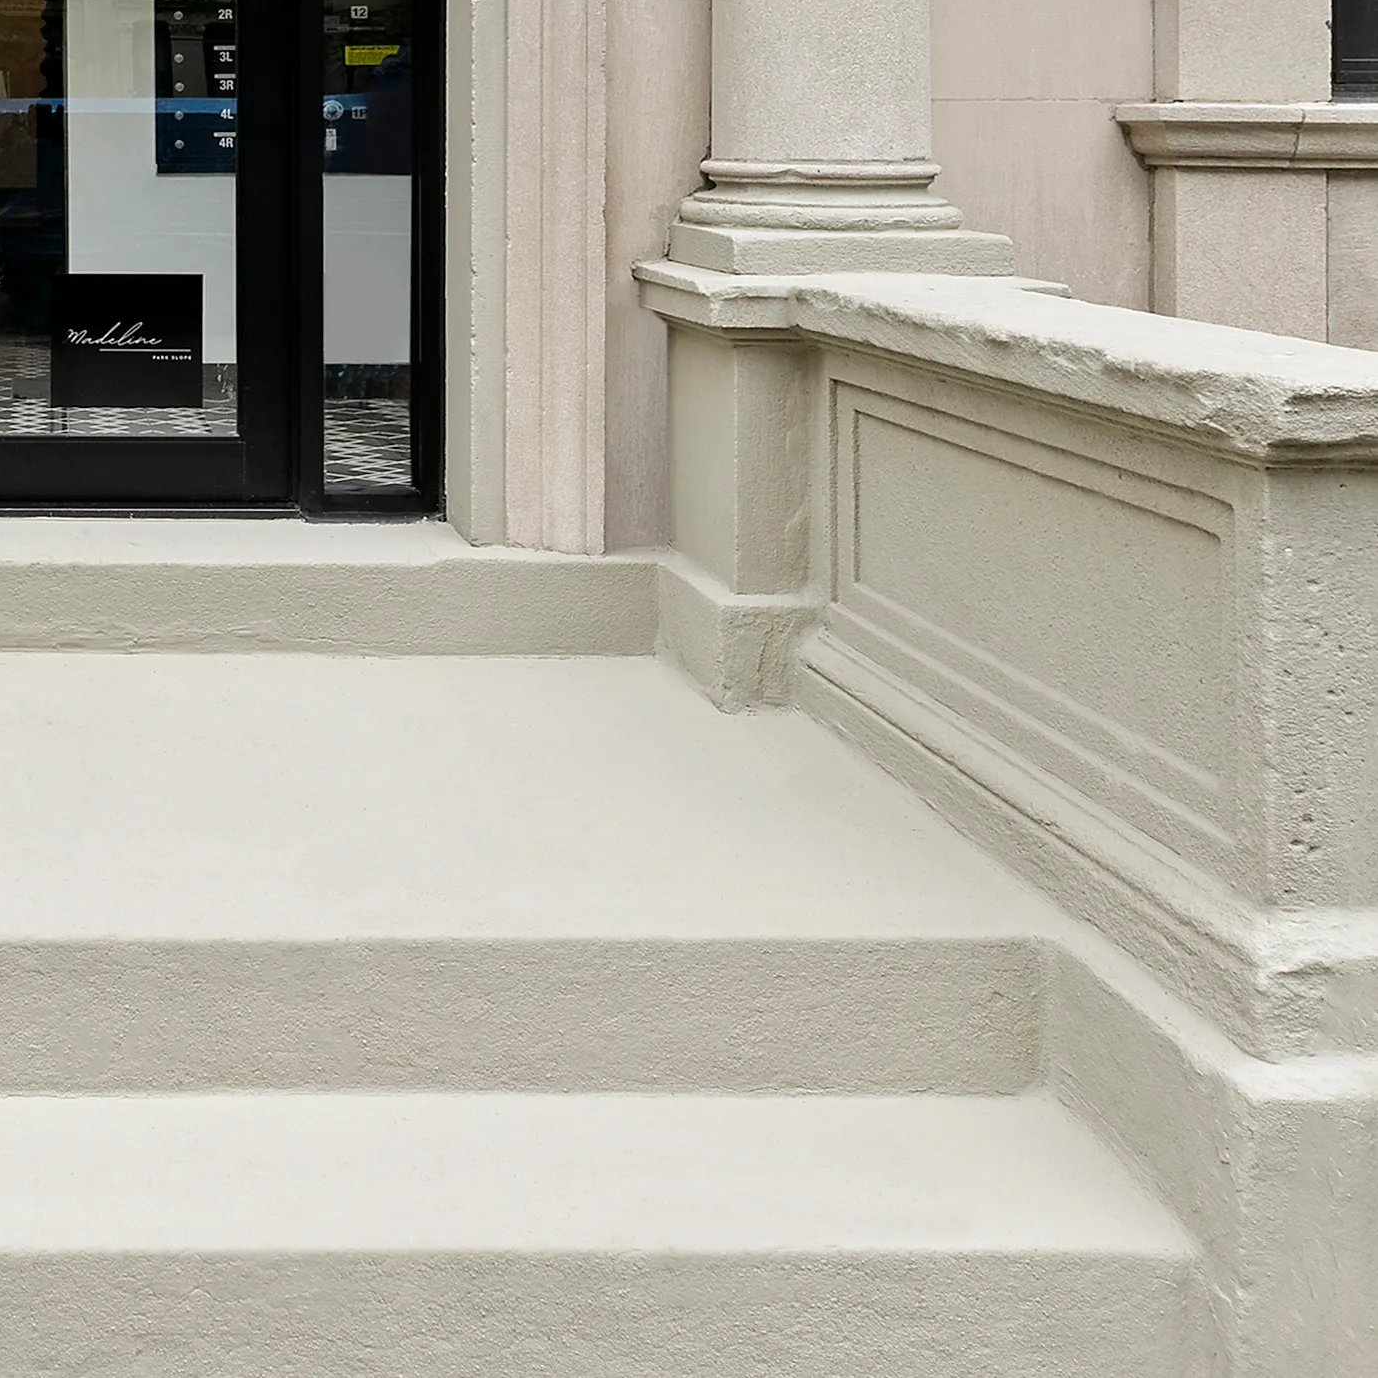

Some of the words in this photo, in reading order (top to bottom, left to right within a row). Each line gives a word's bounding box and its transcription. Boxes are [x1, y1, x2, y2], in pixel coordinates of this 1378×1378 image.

[217, 9, 233, 20] 2R
[352, 7, 367, 17] 12
[219, 51, 233, 62] 3L
[219, 80, 234, 91] 3R
[220, 109, 234, 120] 4L
[218, 137, 234, 148] 4R
[64, 321, 163, 346] Madeline
